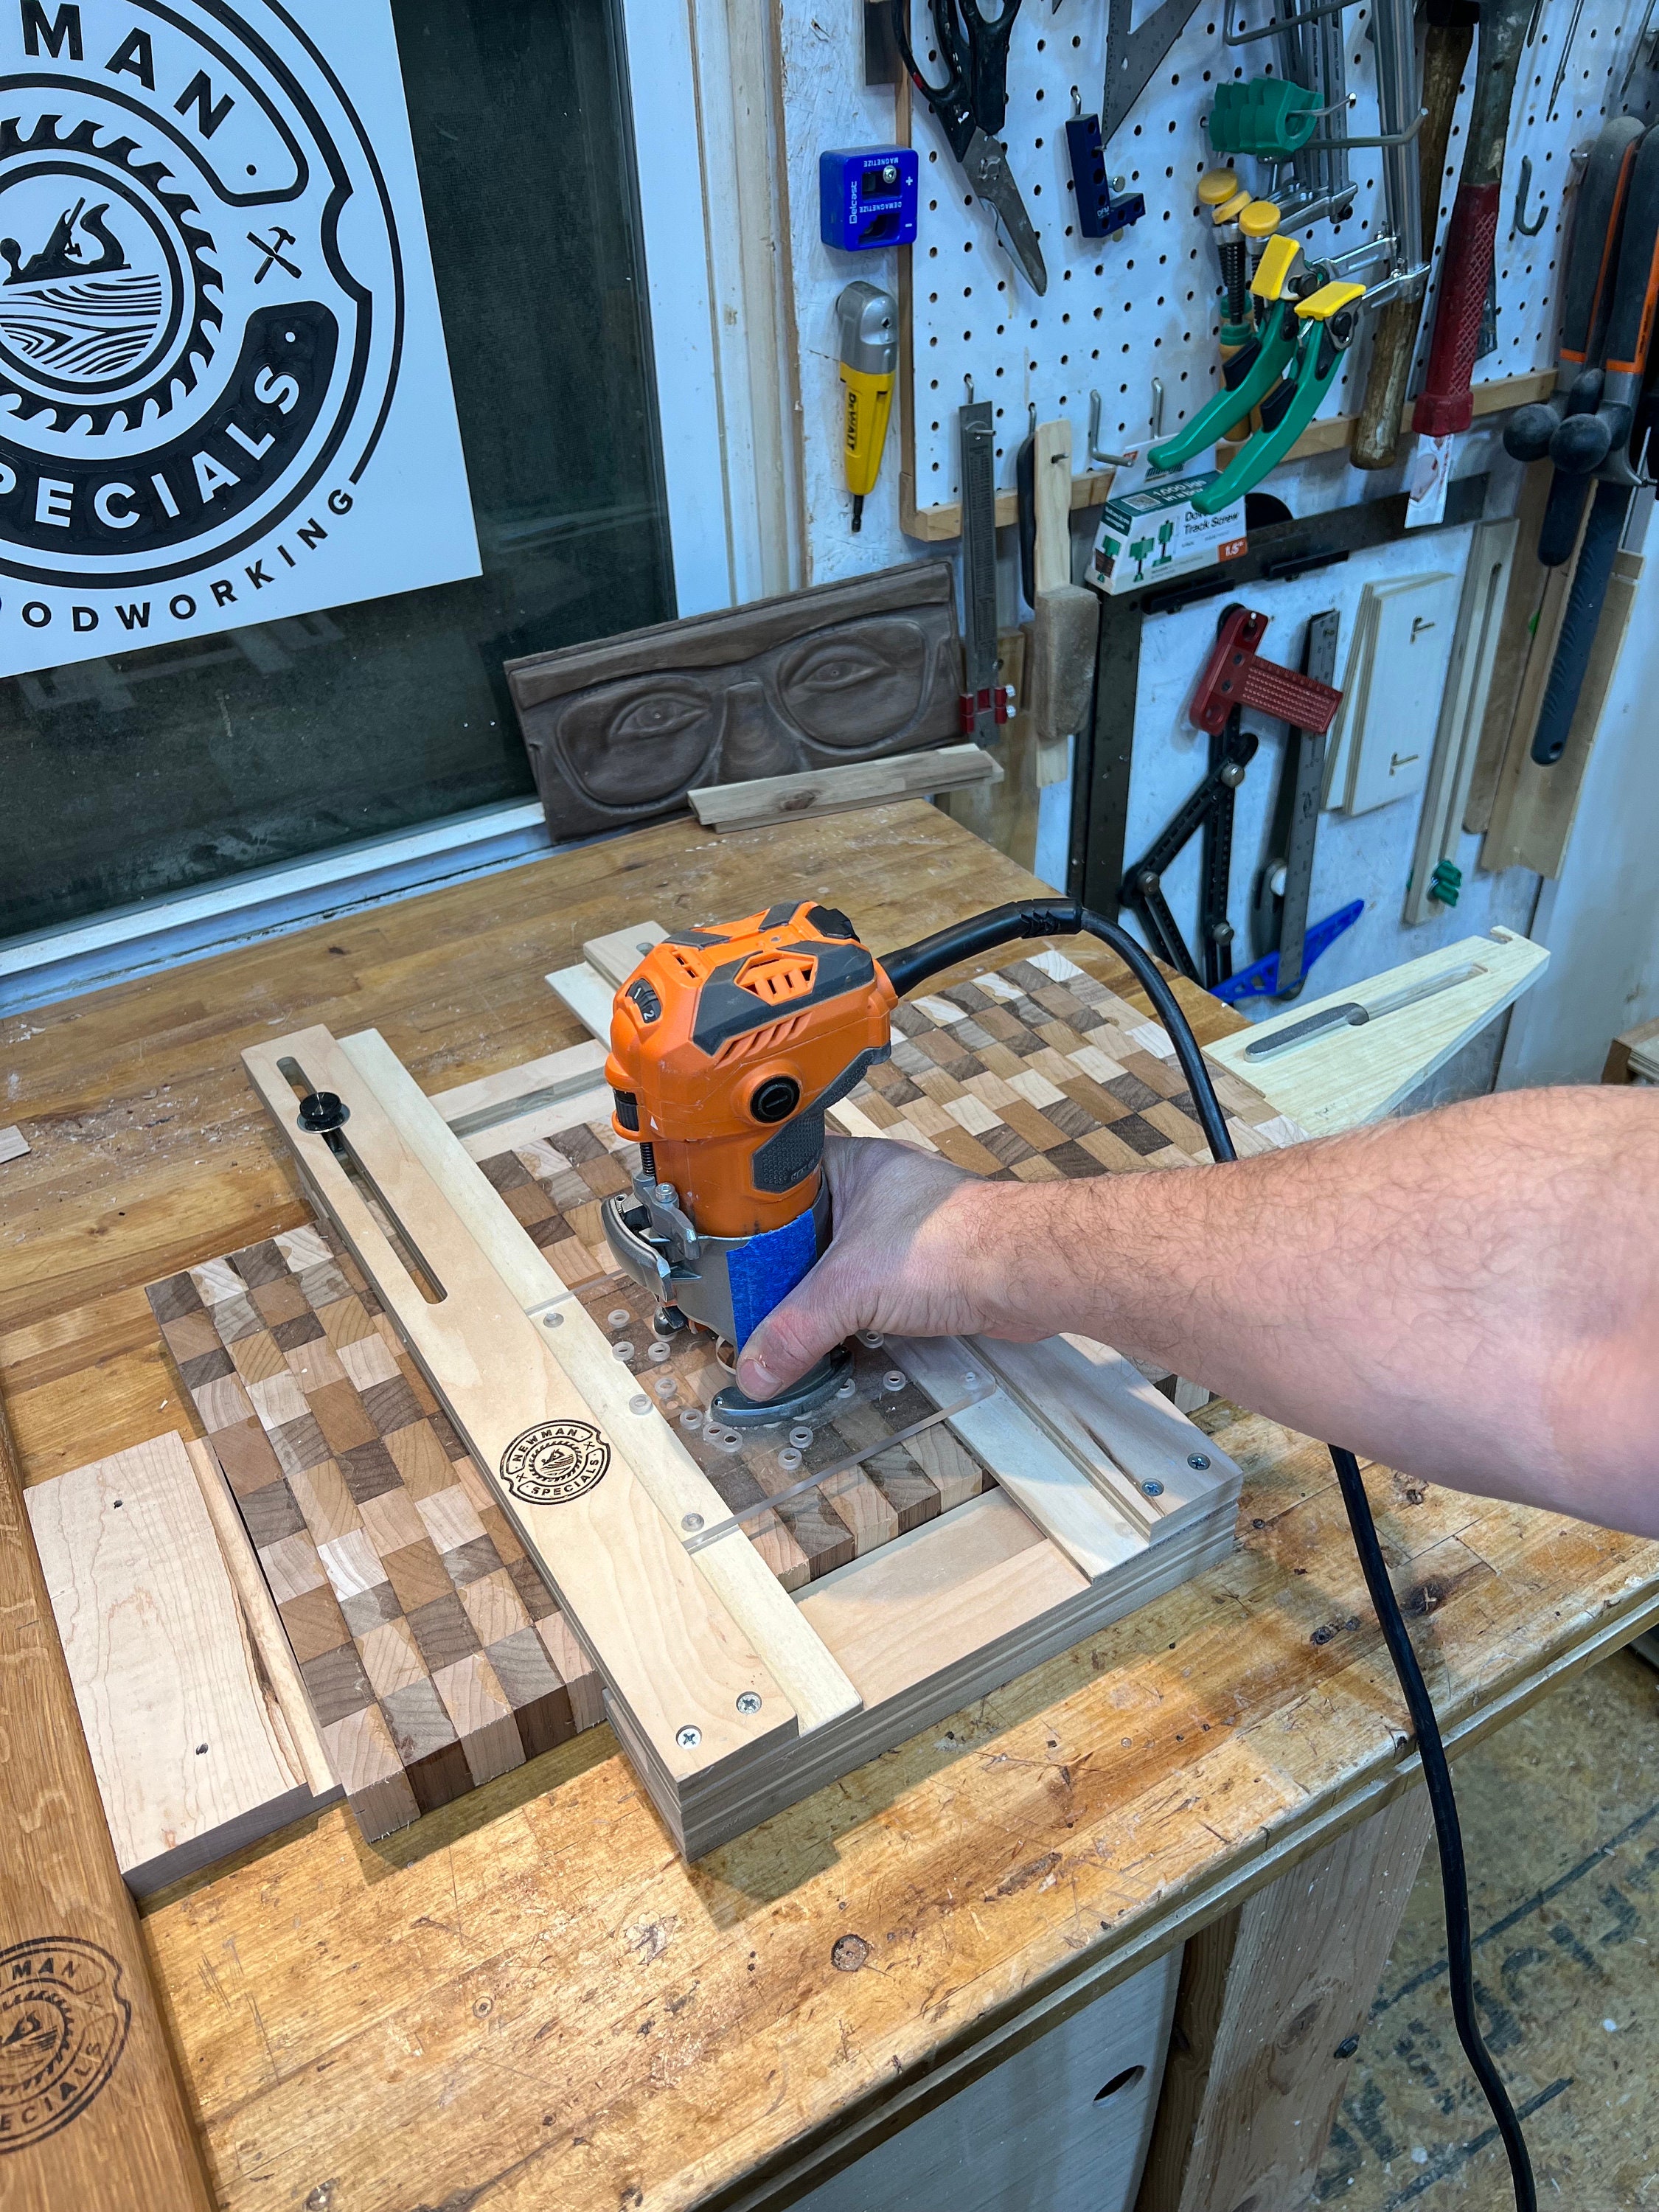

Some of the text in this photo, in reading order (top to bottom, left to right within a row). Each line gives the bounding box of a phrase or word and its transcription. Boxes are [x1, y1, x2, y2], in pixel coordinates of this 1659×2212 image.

[24, 3, 236, 140] MAN
[863, 157, 899, 167] MAGNETIZE
[859, 202, 902, 213] DEMAGNETIZE
[1183, 518, 1210, 535] Track
[1210, 512, 1239, 528] Screw
[0, 489, 355, 633] ODWORKING
[634, 987, 642, 1000] 1
[644, 1009, 655, 1020] 2
[512, 1427, 578, 1462] NEWMAN
[530, 1459, 599, 1496] SPECIALS
[12, 1957, 80, 1980] MAN
